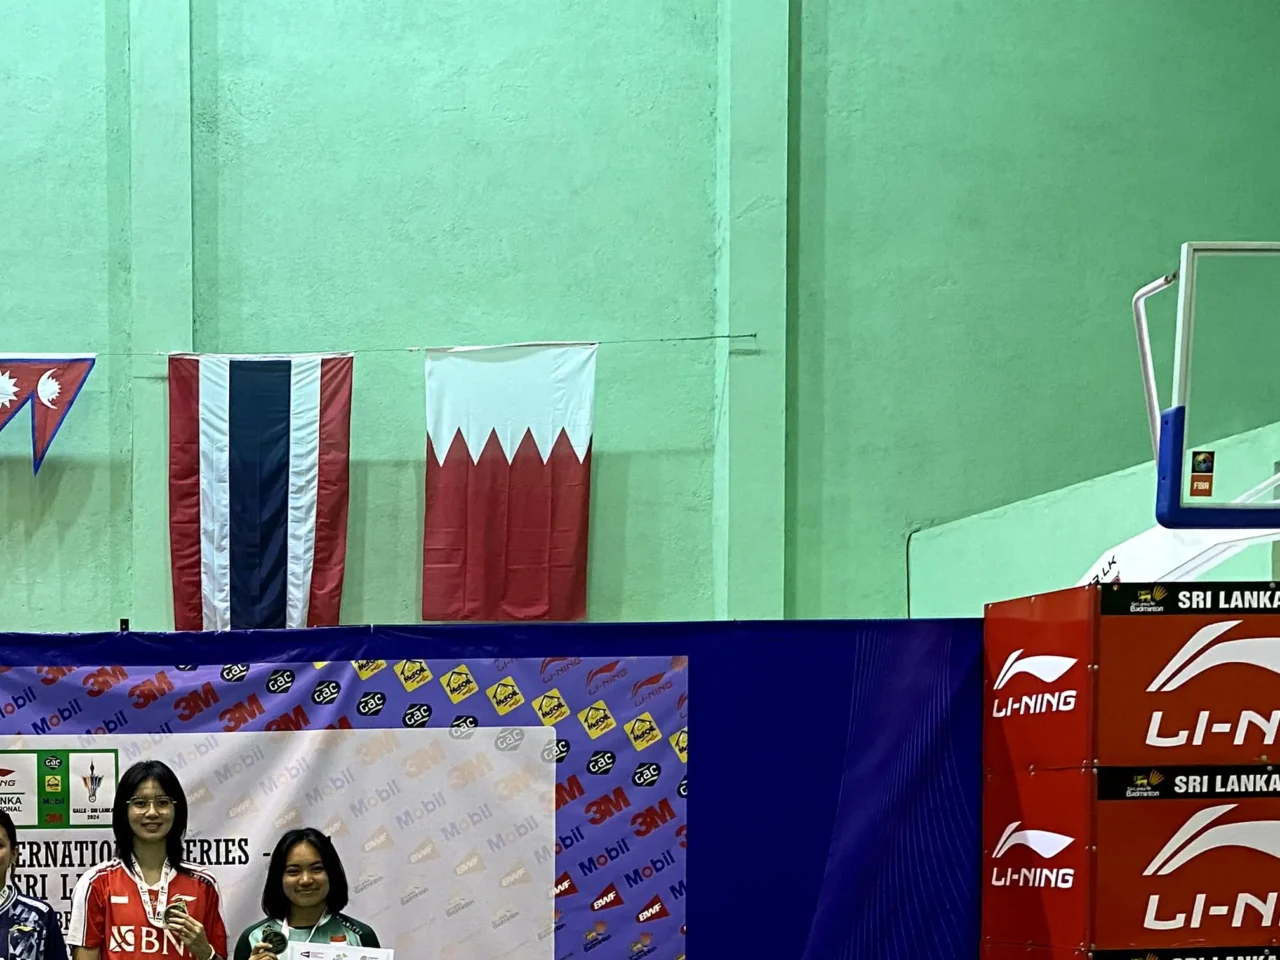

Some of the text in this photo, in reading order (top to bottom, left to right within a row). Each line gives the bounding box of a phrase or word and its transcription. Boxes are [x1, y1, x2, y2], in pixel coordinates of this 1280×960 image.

[1178, 590, 1280, 609] SRI LANKA
[128, 671, 175, 709] 3M
[174, 682, 220, 721] 3M
[992, 690, 1077, 718] LI-NING
[31, 698, 83, 735] Mobil
[219, 693, 266, 732] 3M
[1174, 775, 1280, 793] SRI LANKA
[45, 813, 63, 823] 3M
[584, 786, 631, 825] 3M
[630, 797, 677, 837] 3M
[185, 838, 250, 866] ERIES
[578, 838, 630, 876] Mobil
[624, 850, 675, 888] Mobil
[991, 867, 1075, 888] LI-NING
[593, 891, 616, 910] BWF
[638, 902, 662, 922] BWF
[140, 928, 196, 957] BN
